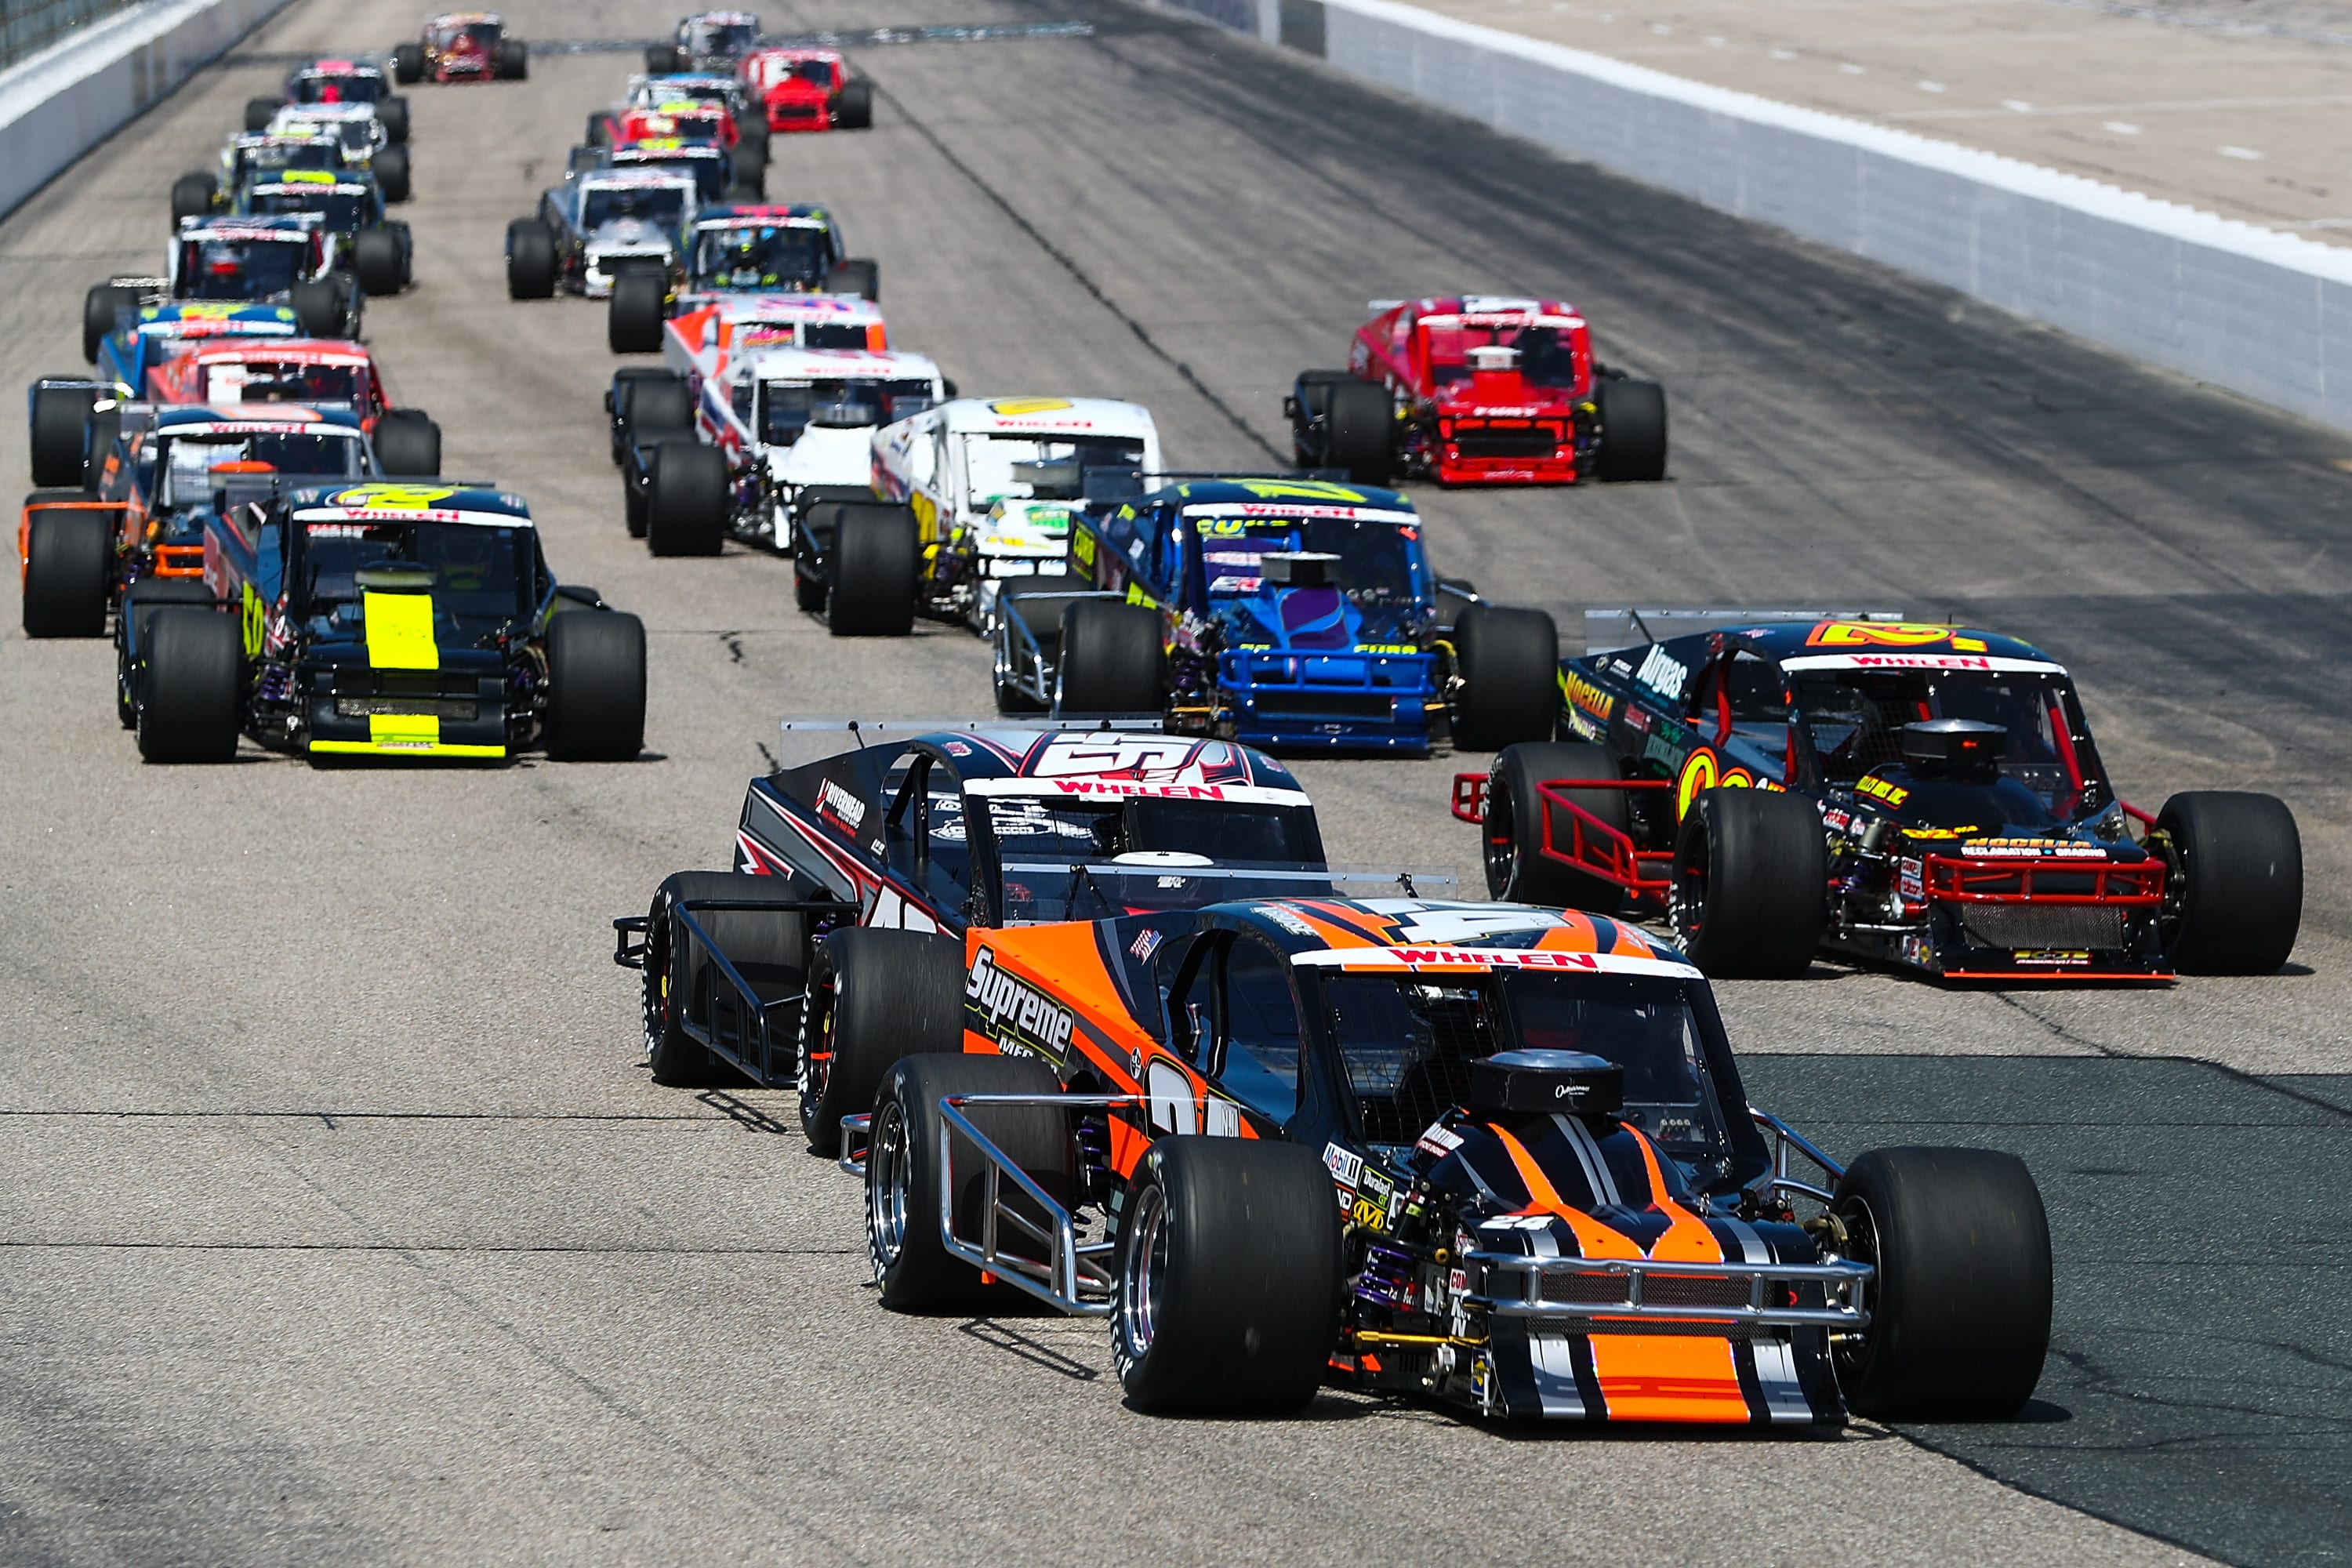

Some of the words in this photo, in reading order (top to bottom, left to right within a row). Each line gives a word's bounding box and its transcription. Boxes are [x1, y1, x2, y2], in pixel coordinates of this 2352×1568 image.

[1849, 656, 1991, 670] WHELEN
[1053, 780, 1225, 801] WHELEN
[825, 781, 866, 823] RIVERHEAD
[1961, 847, 2042, 857] RECLAMATION
[2054, 848, 2108, 858] GRADING
[1965, 837, 2092, 848] NOCELLA
[1387, 949, 1599, 969] WHELEN
[966, 948, 1072, 1053] Supreme
[1324, 1145, 1349, 1174] Mobil
[1348, 1158, 1358, 1178] 1
[1363, 1169, 1391, 1197] Duralast
[1378, 1194, 1388, 1207] GT
[1479, 1215, 1555, 1230] 24
